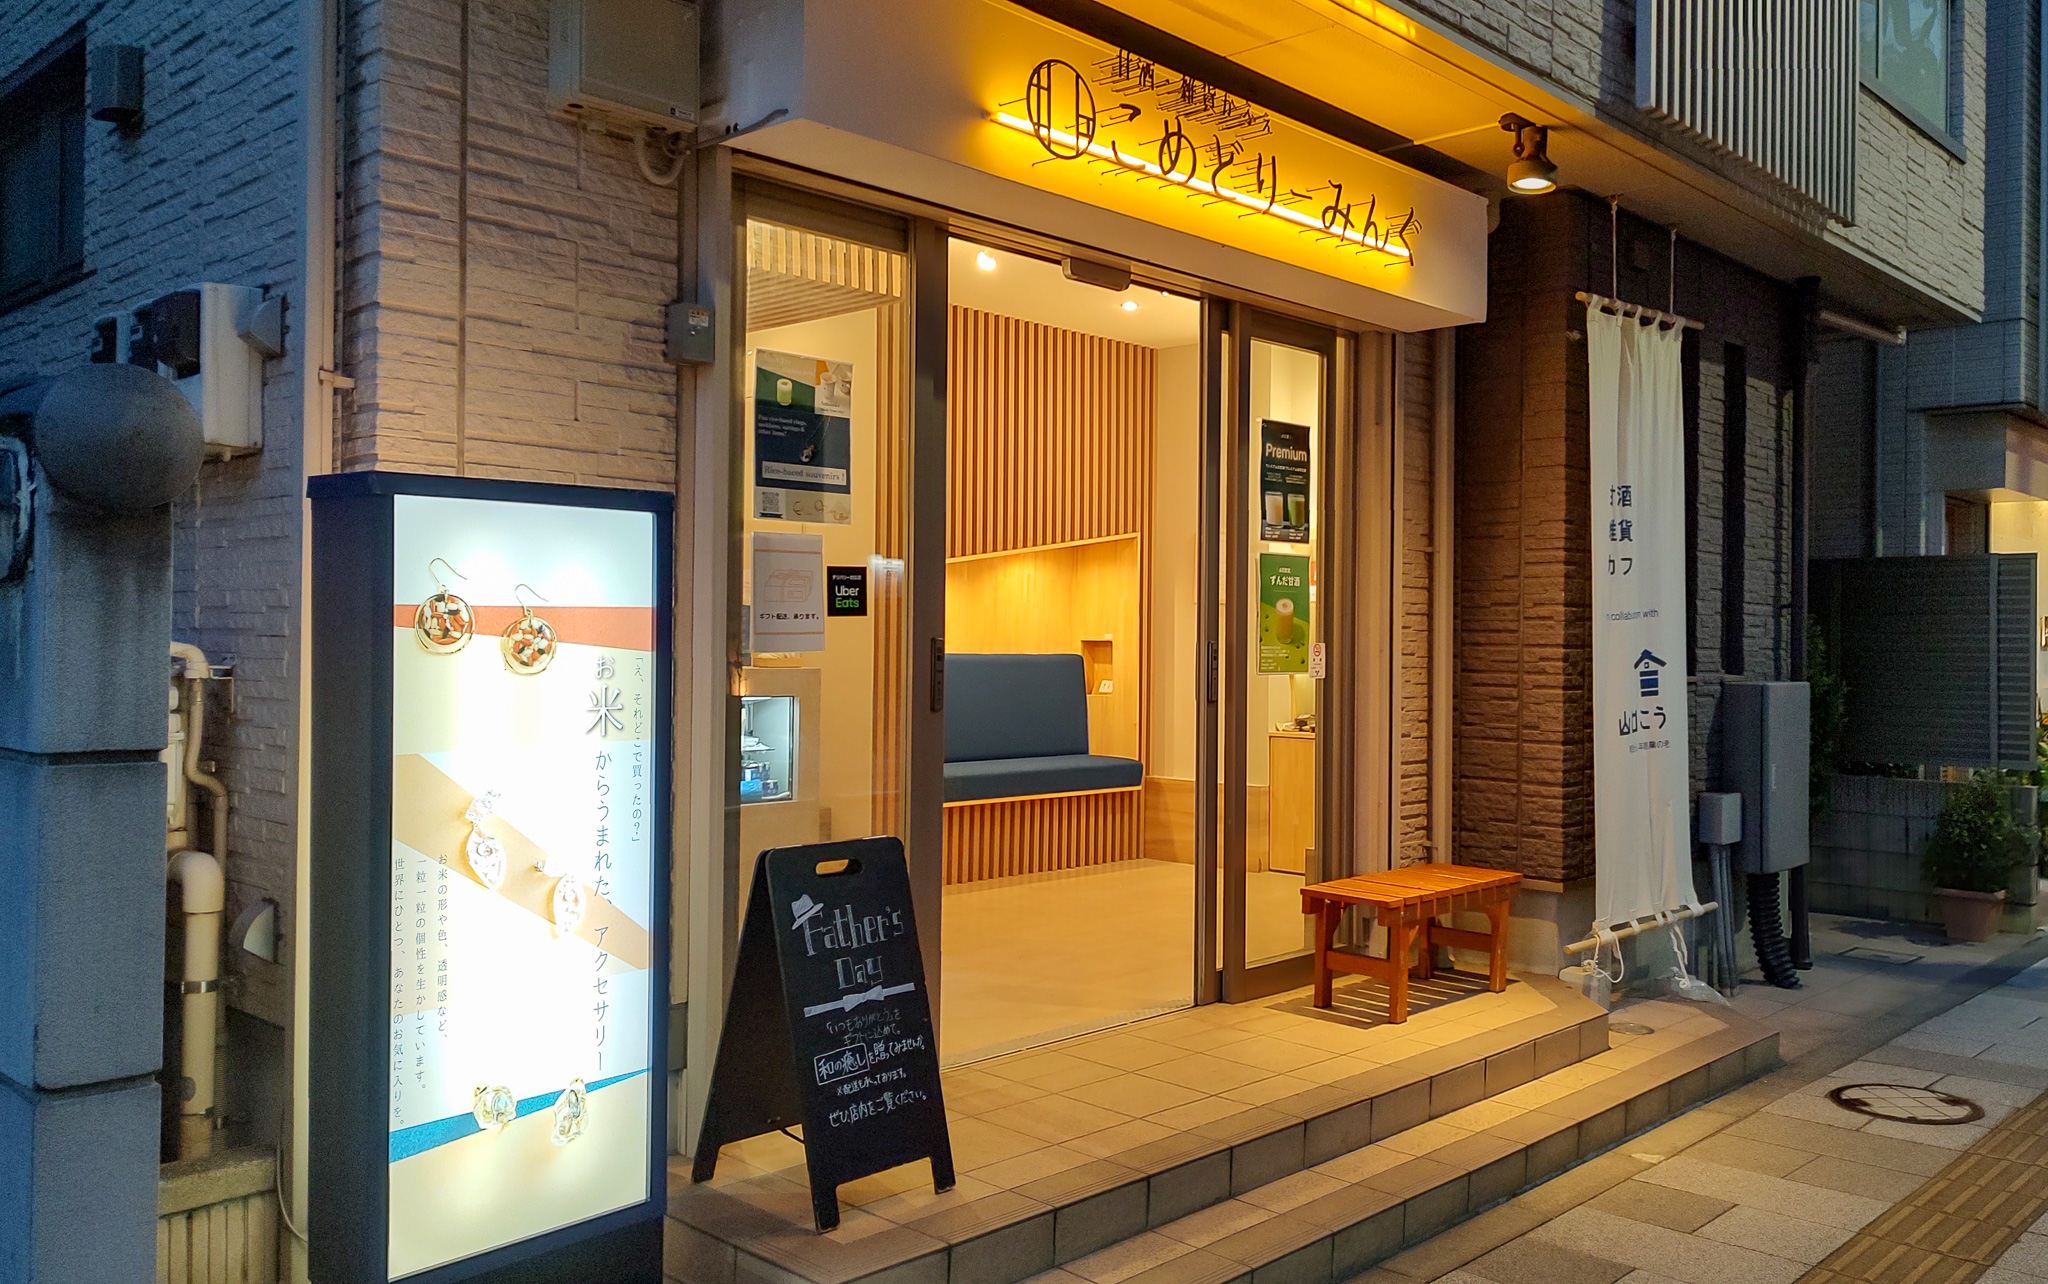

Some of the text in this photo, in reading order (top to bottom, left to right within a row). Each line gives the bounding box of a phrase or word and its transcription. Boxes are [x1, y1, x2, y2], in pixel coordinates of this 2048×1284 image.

[1265, 442, 1307, 462] Premium
[805, 470, 840, 480] souvenirs
[835, 585, 859, 596] Uber
[835, 598, 860, 608] Eats
[1643, 608, 1659, 618] with
[802, 904, 904, 957] Father's
[437, 854, 448, 1037] お米の形や色、透明感など、
[415, 859, 427, 1089] 一粒一粒の個性を生かしています。
[834, 955, 884, 990] Day
[393, 857, 406, 1125] 世界にひとつ、あなたのお気に入りを。
